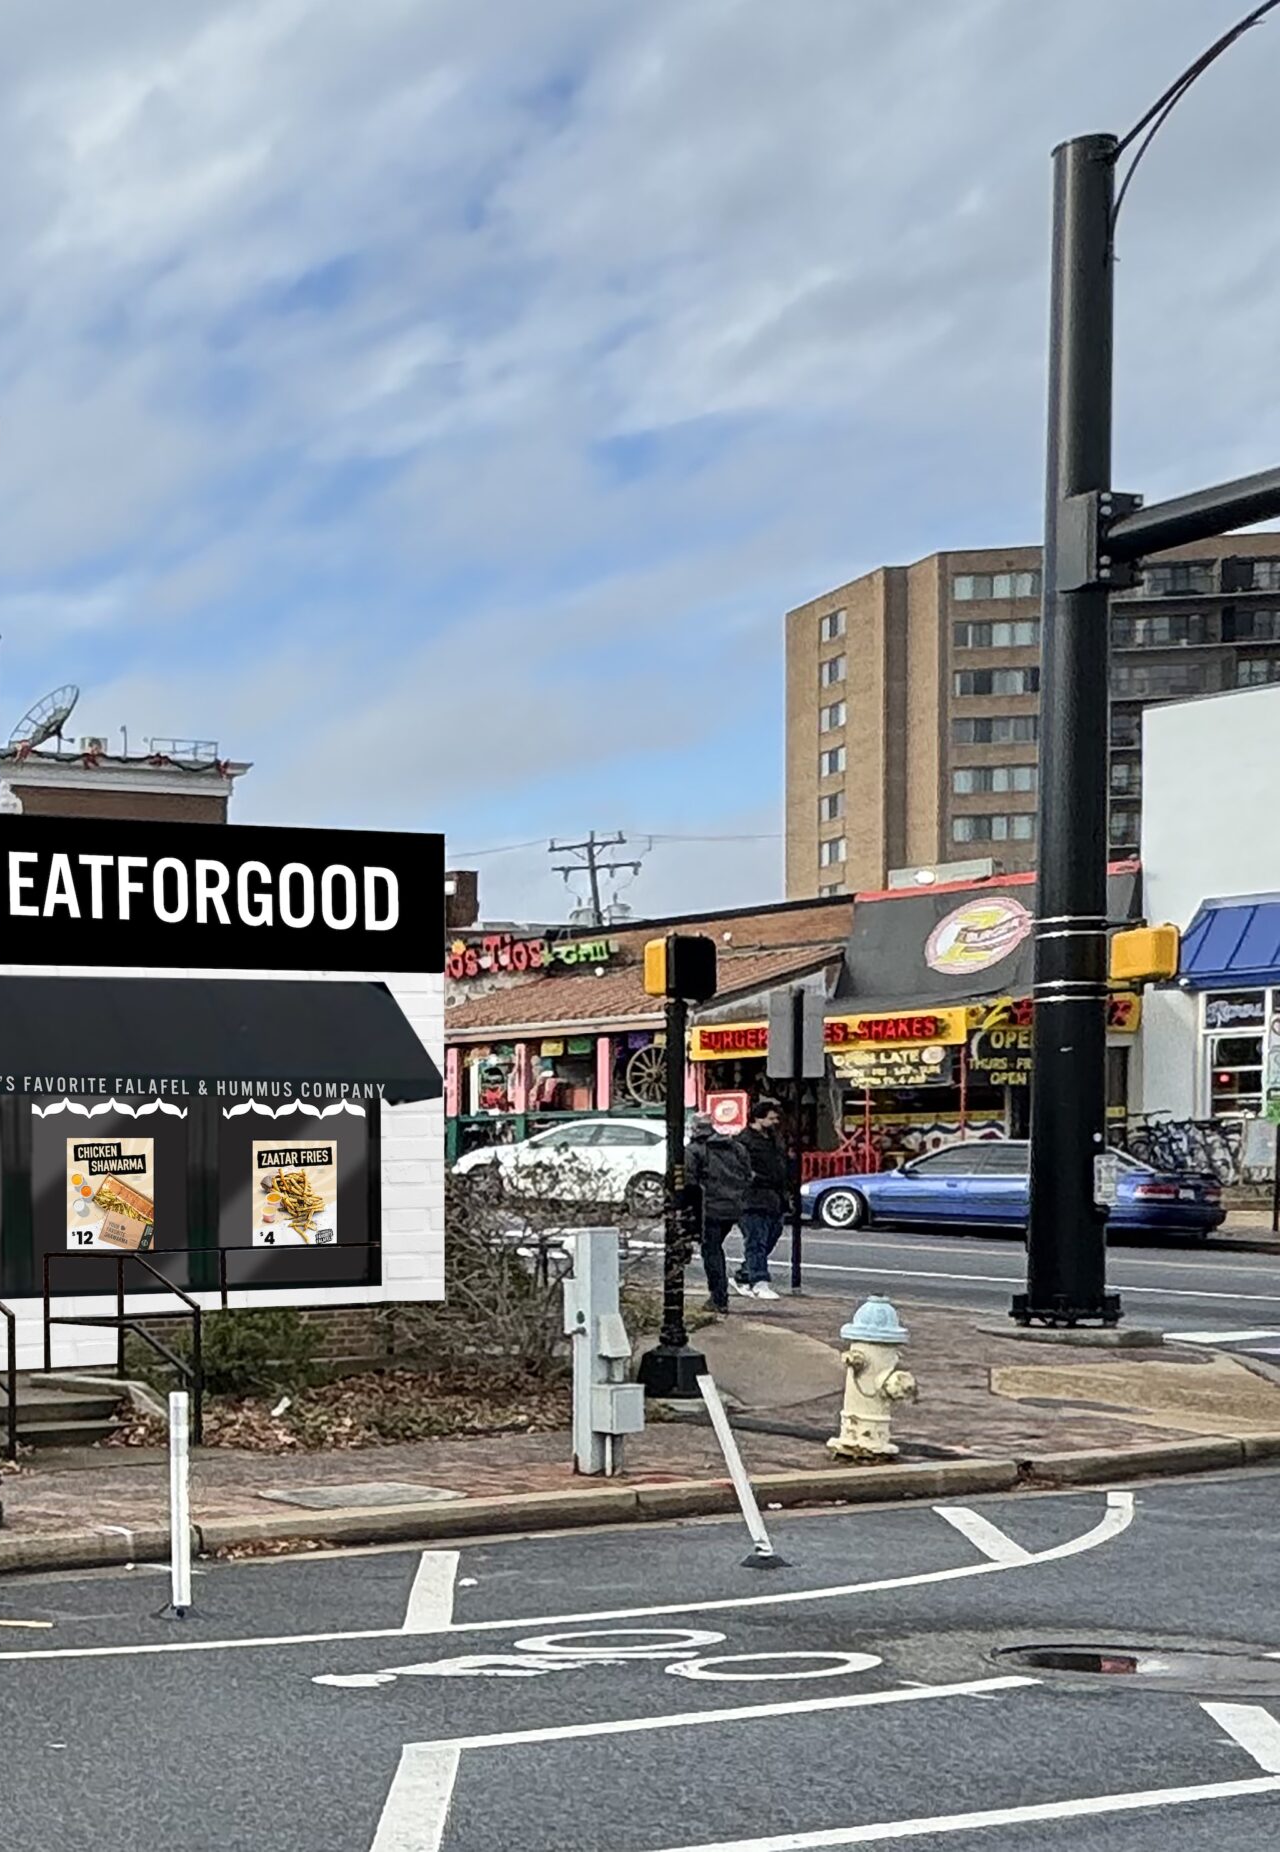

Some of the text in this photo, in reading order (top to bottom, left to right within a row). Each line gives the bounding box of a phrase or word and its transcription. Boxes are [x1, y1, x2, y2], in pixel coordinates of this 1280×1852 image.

[8, 851, 399, 931] EATFORGOOD
[446, 949, 478, 979] os
[483, 934, 544, 973] Tios
[699, 1028, 768, 1051] BURGER
[857, 1016, 937, 1041] SHAKES
[990, 1031, 1035, 1049] OPE
[880, 1050, 920, 1064] LATE
[989, 1071, 1028, 1086] OPEN
[23, 1076, 107, 1094] FAVORITE
[115, 1078, 190, 1095] FALAFEL
[198, 1079, 209, 1096] &
[216, 1080, 293, 1098] HUMMUS
[301, 1081, 386, 1099] COMPANY
[77, 1145, 118, 1159] CHICKEN
[261, 1149, 329, 1166] ZAATAR FRIES
[91, 1158, 144, 1173] SHAWARMA
[71, 1231, 94, 1246] $12
[260, 1231, 276, 1245] $4
